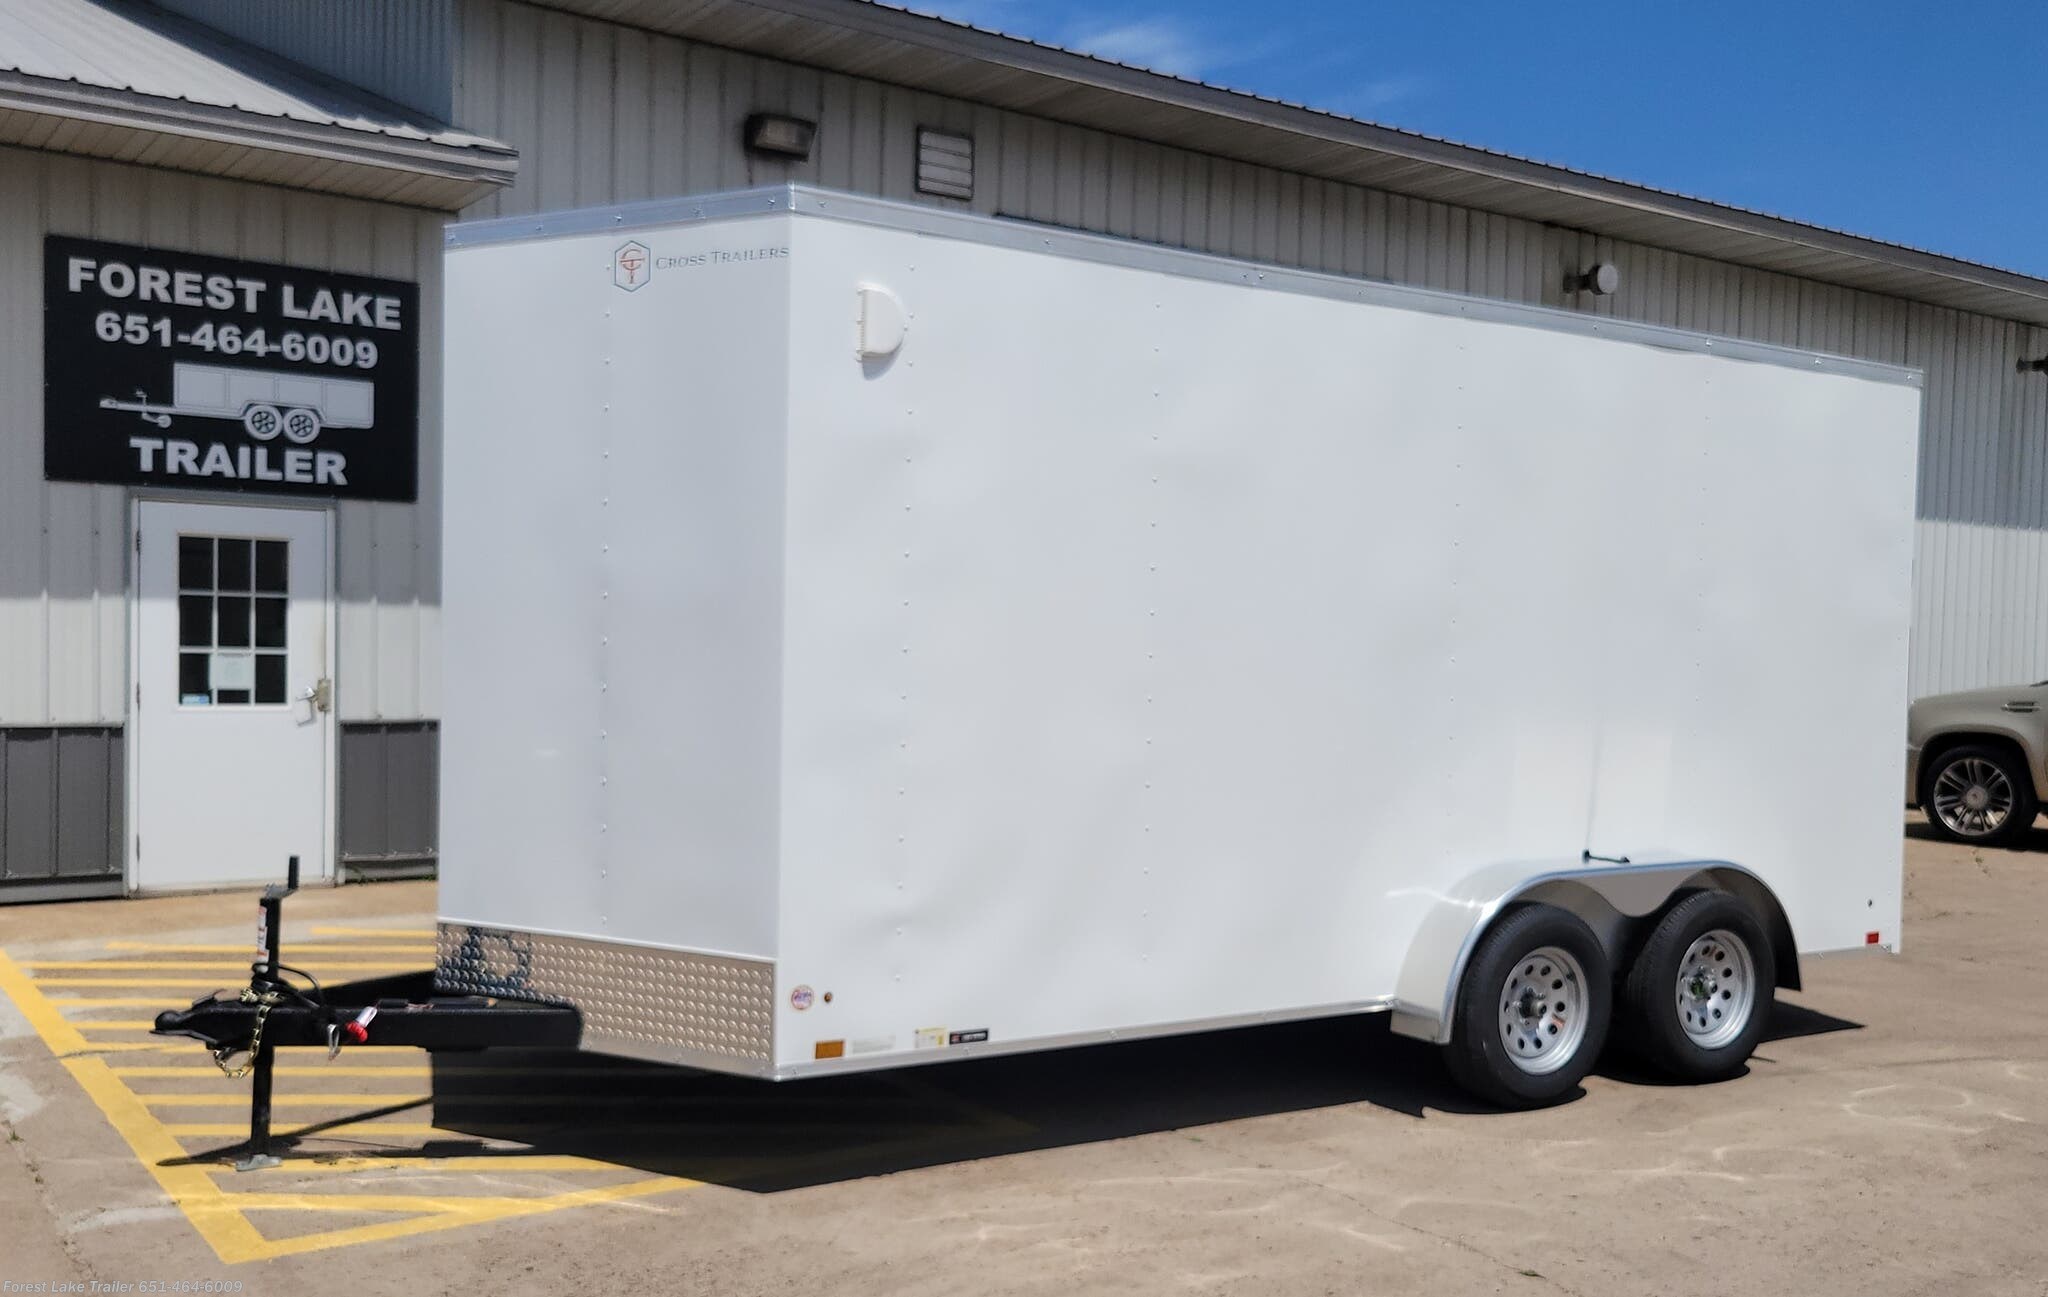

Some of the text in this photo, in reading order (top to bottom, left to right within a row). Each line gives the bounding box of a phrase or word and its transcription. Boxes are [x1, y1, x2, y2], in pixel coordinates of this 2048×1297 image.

[67, 257, 401, 331] FOREST LAKE
[95, 312, 378, 369] 651-464-6009
[129, 437, 348, 485] TRAILER
